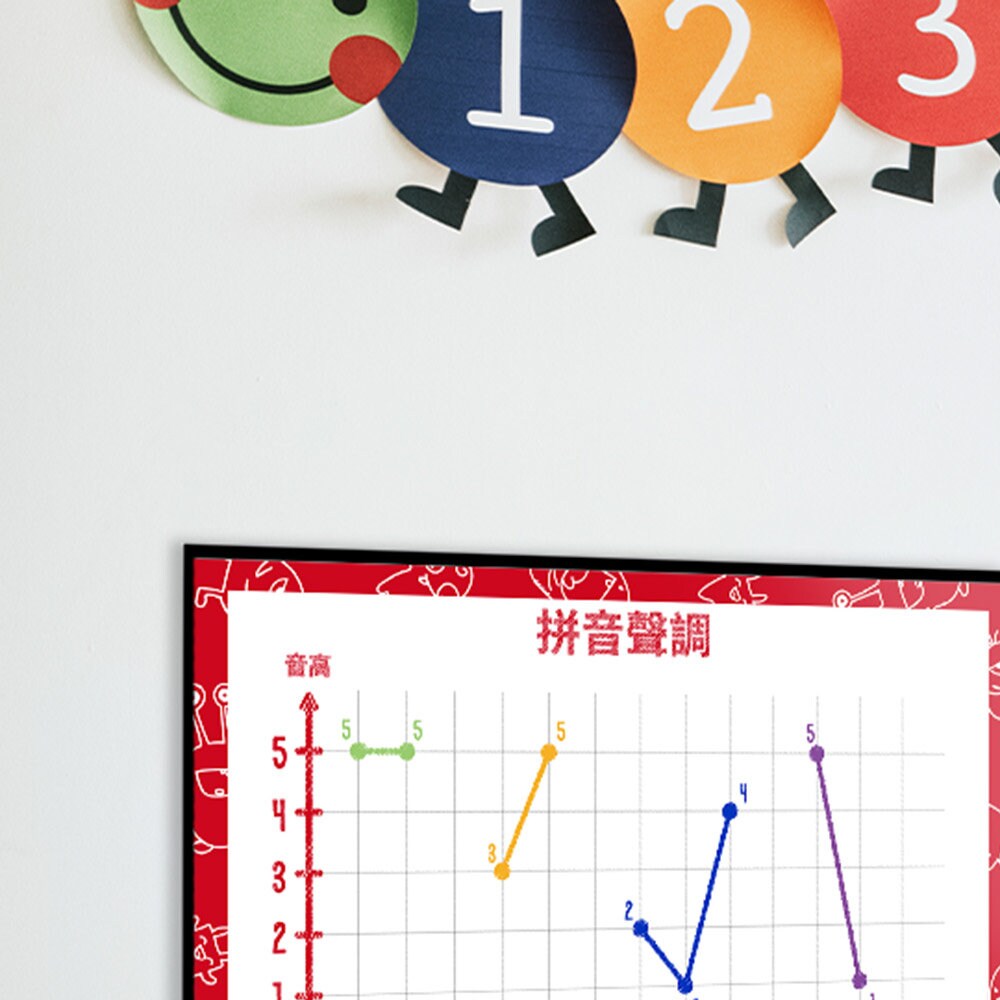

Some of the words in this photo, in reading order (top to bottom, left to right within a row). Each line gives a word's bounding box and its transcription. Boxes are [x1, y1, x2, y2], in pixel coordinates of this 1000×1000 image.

[898, 0, 976, 97] 3
[468, 0, 554, 133] 1
[665, 0, 773, 131] 2
[536, 608, 711, 658] 拼音聲調
[285, 652, 332, 678] 音高
[341, 719, 351, 740] 5
[412, 720, 423, 741] 5
[556, 720, 567, 742] 5
[806, 723, 815, 743] 5
[272, 735, 288, 769] 5
[738, 783, 748, 803] 4
[272, 798, 286, 832] 4
[487, 842, 497, 863] 3
[272, 860, 286, 894] 3
[624, 899, 634, 921] 2
[272, 921, 288, 955] 2
